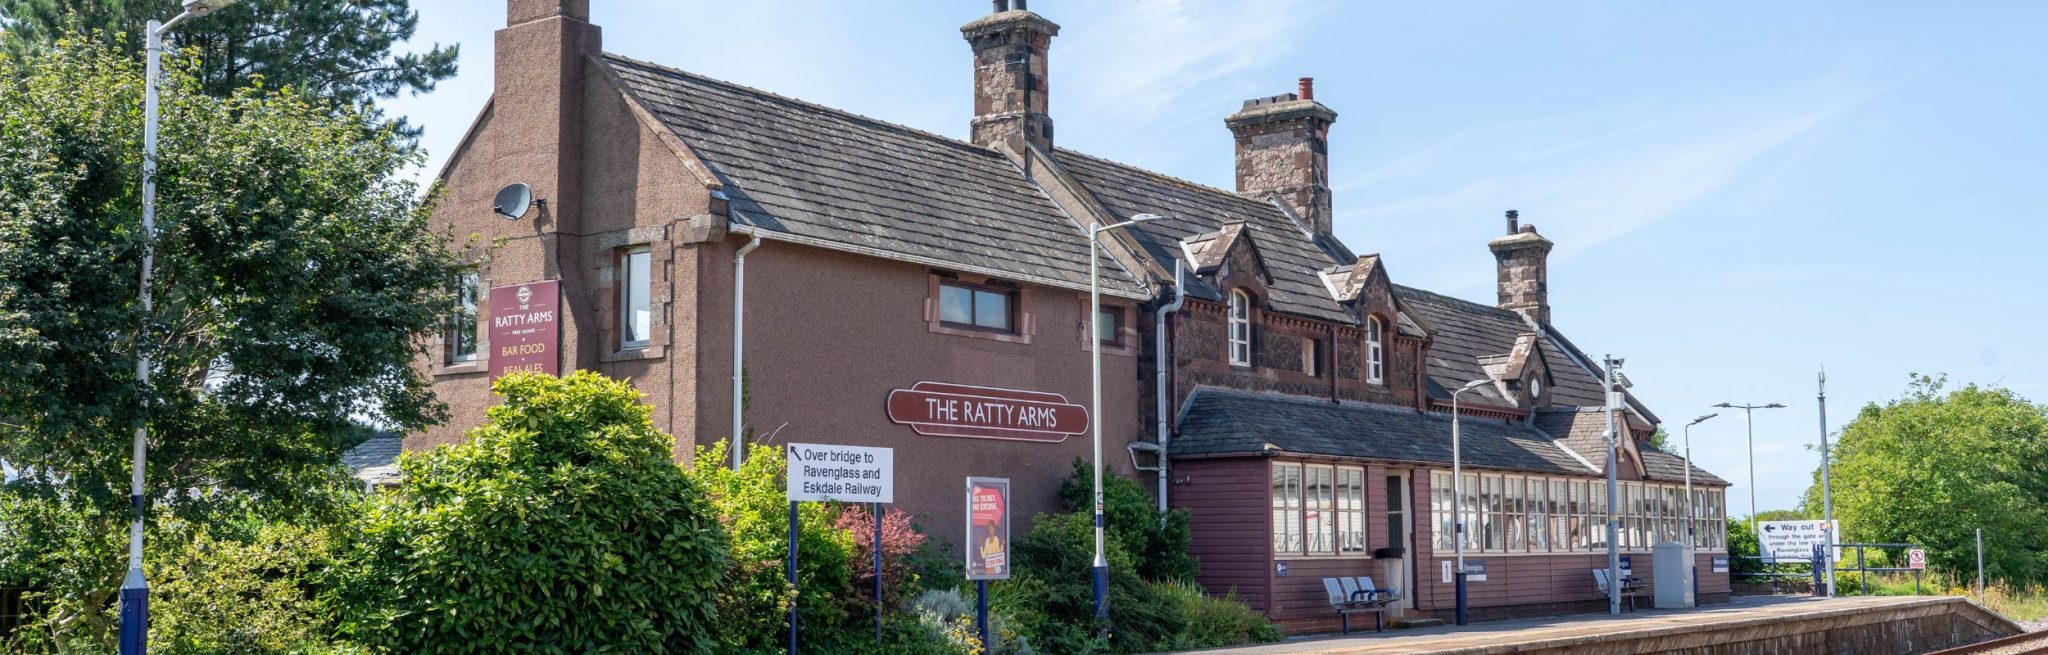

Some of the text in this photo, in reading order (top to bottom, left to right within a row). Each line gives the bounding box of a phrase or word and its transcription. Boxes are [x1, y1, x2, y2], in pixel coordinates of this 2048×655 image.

[495, 311, 552, 327] RATTY ARMS
[502, 342, 545, 356] BAR FOOD
[524, 363, 543, 374] ALES
[925, 397, 1057, 428] THE RATTY ARMS
[804, 448, 874, 465] Over bridge to
[803, 465, 880, 480] Ravenglass and
[803, 481, 882, 497] Eskdale Railway
[1801, 523, 1814, 531] out
[1445, 564, 1448, 579] 1
